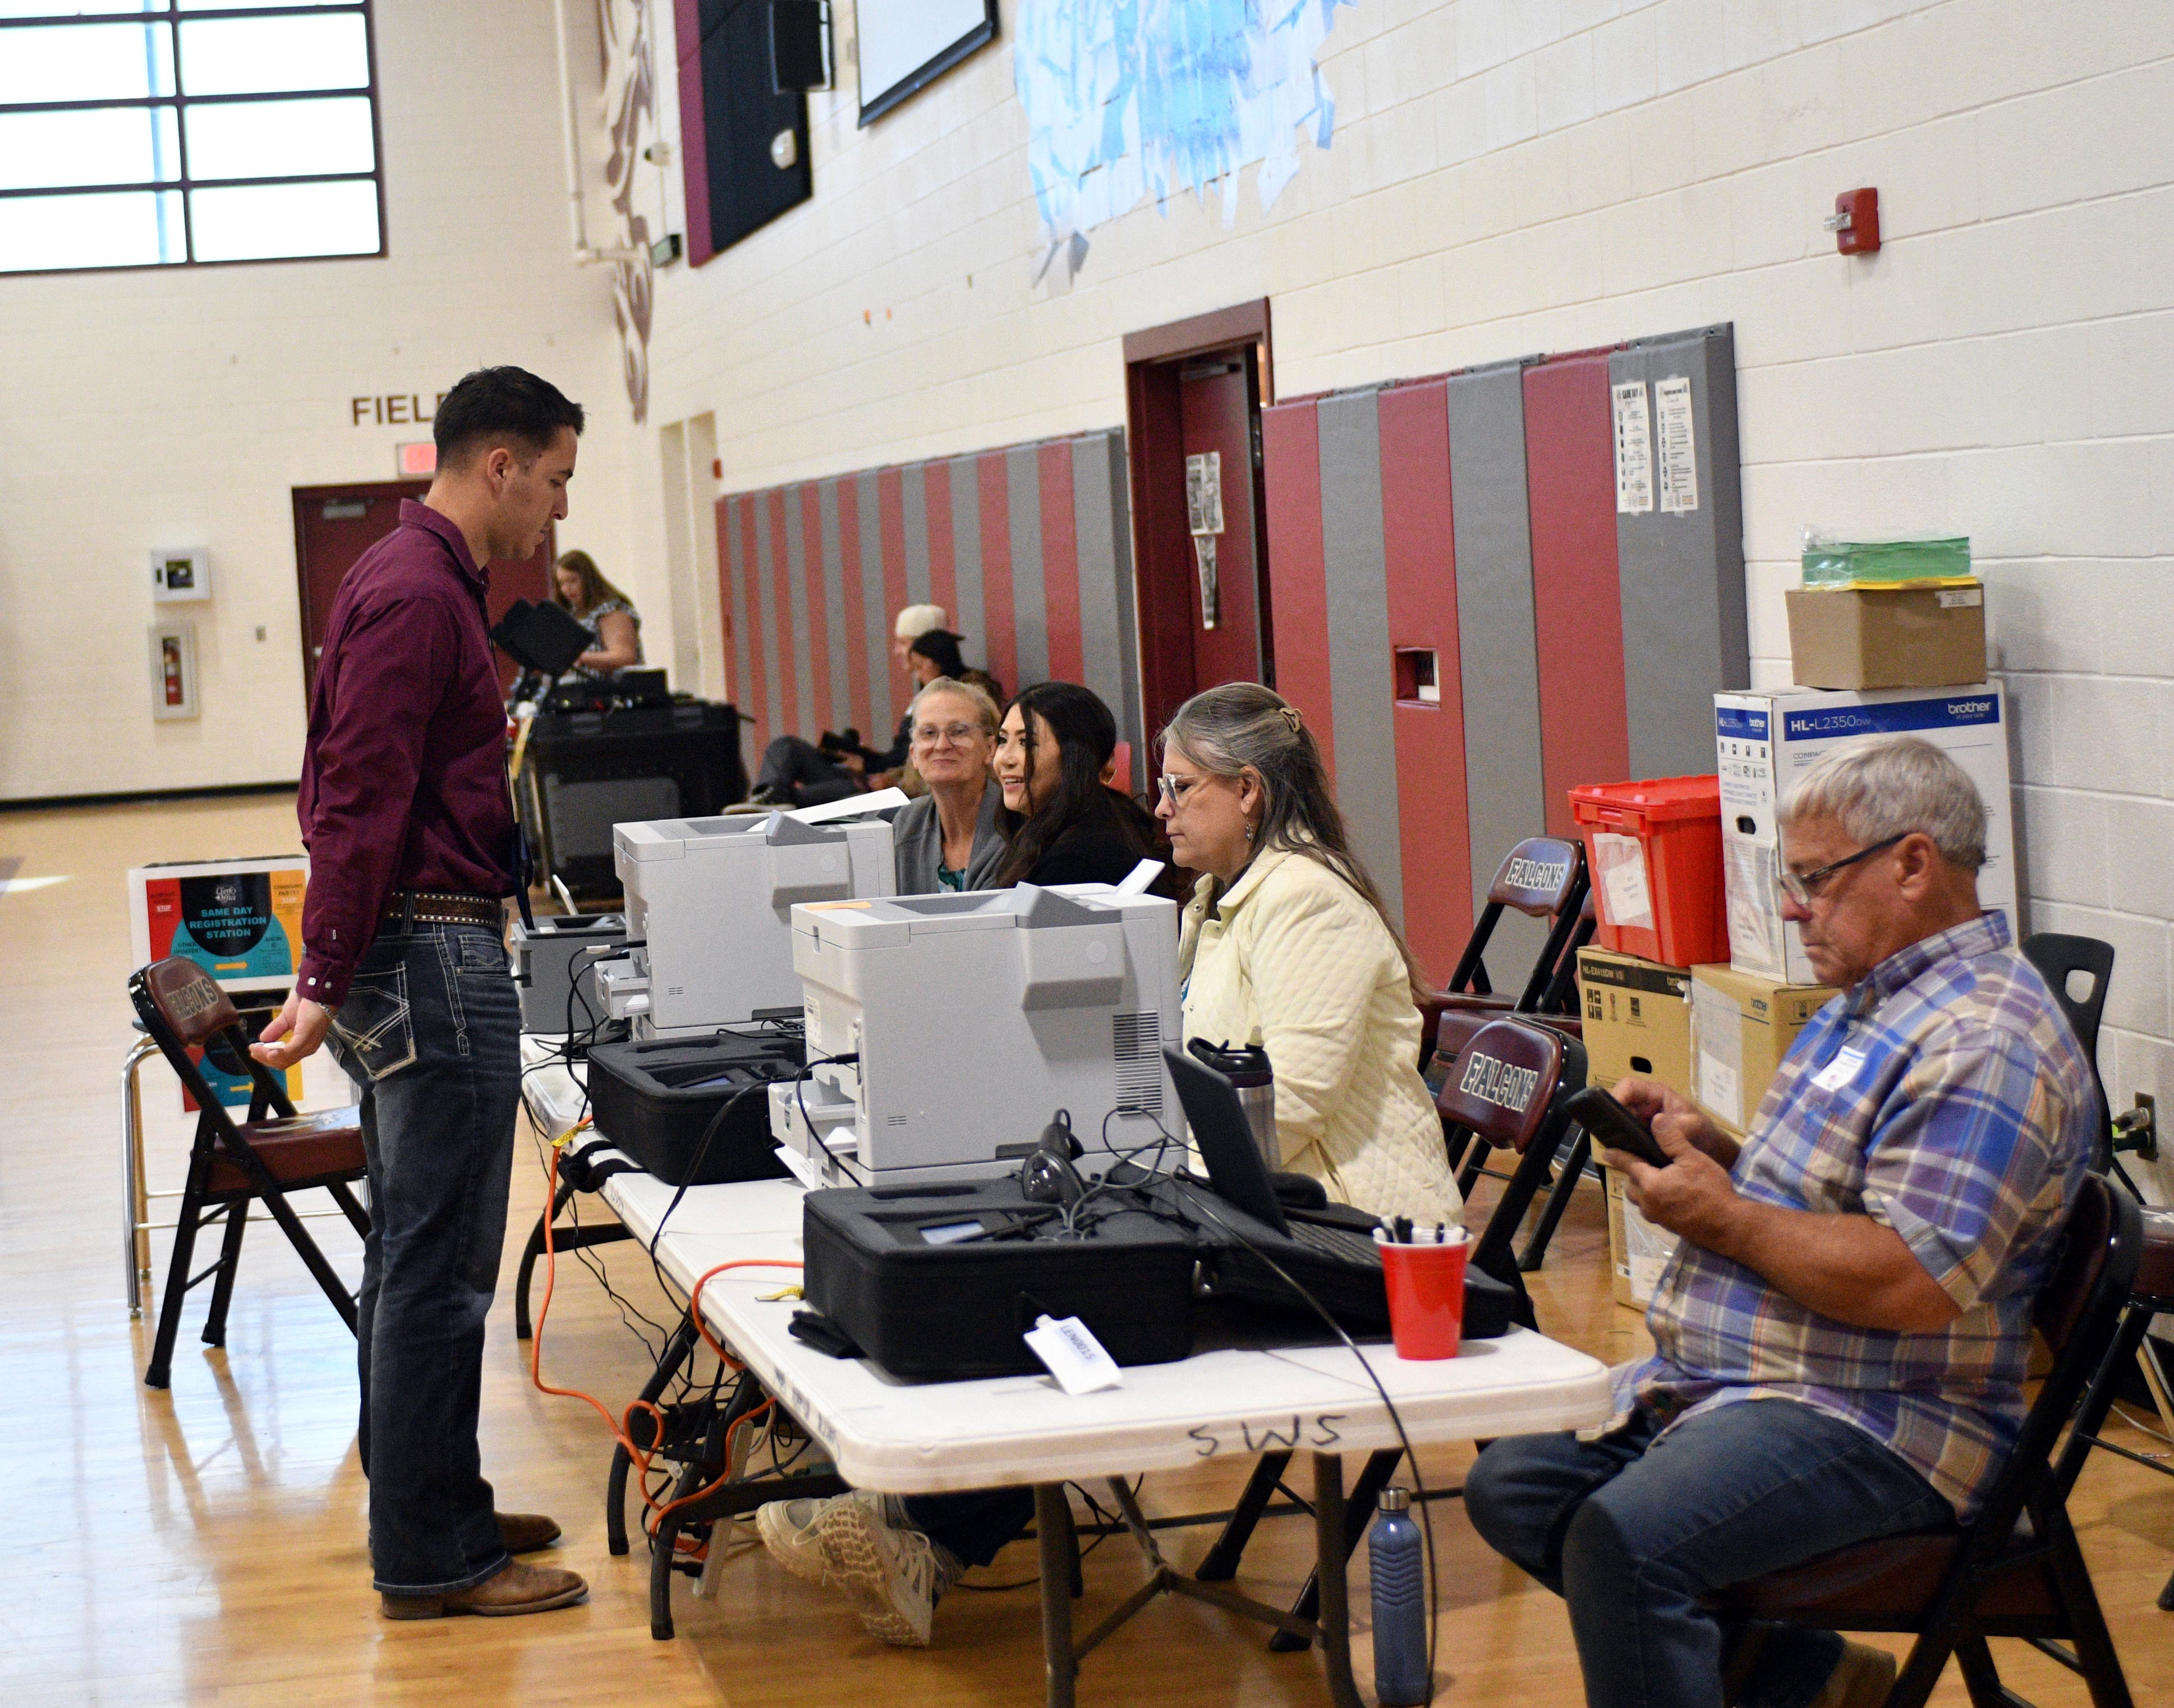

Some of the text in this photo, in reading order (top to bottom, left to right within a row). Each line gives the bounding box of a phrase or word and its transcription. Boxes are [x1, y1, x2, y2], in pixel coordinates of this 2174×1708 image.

[1947, 701, 1991, 715] brother
[1749, 717, 1766, 728] brother
[1791, 715, 1871, 732] HL-L2350DW
[1505, 858, 1565, 891] FALCONS
[201, 906, 253, 917] SAME DAY
[190, 916, 267, 929] REGISTRATION
[206, 928, 251, 939] STATION
[1666, 975, 1681, 987] brot
[1750, 998, 1767, 1011] brother
[1460, 1051, 1538, 1112] FALCONS
[1187, 1414, 1346, 1456] SWS
